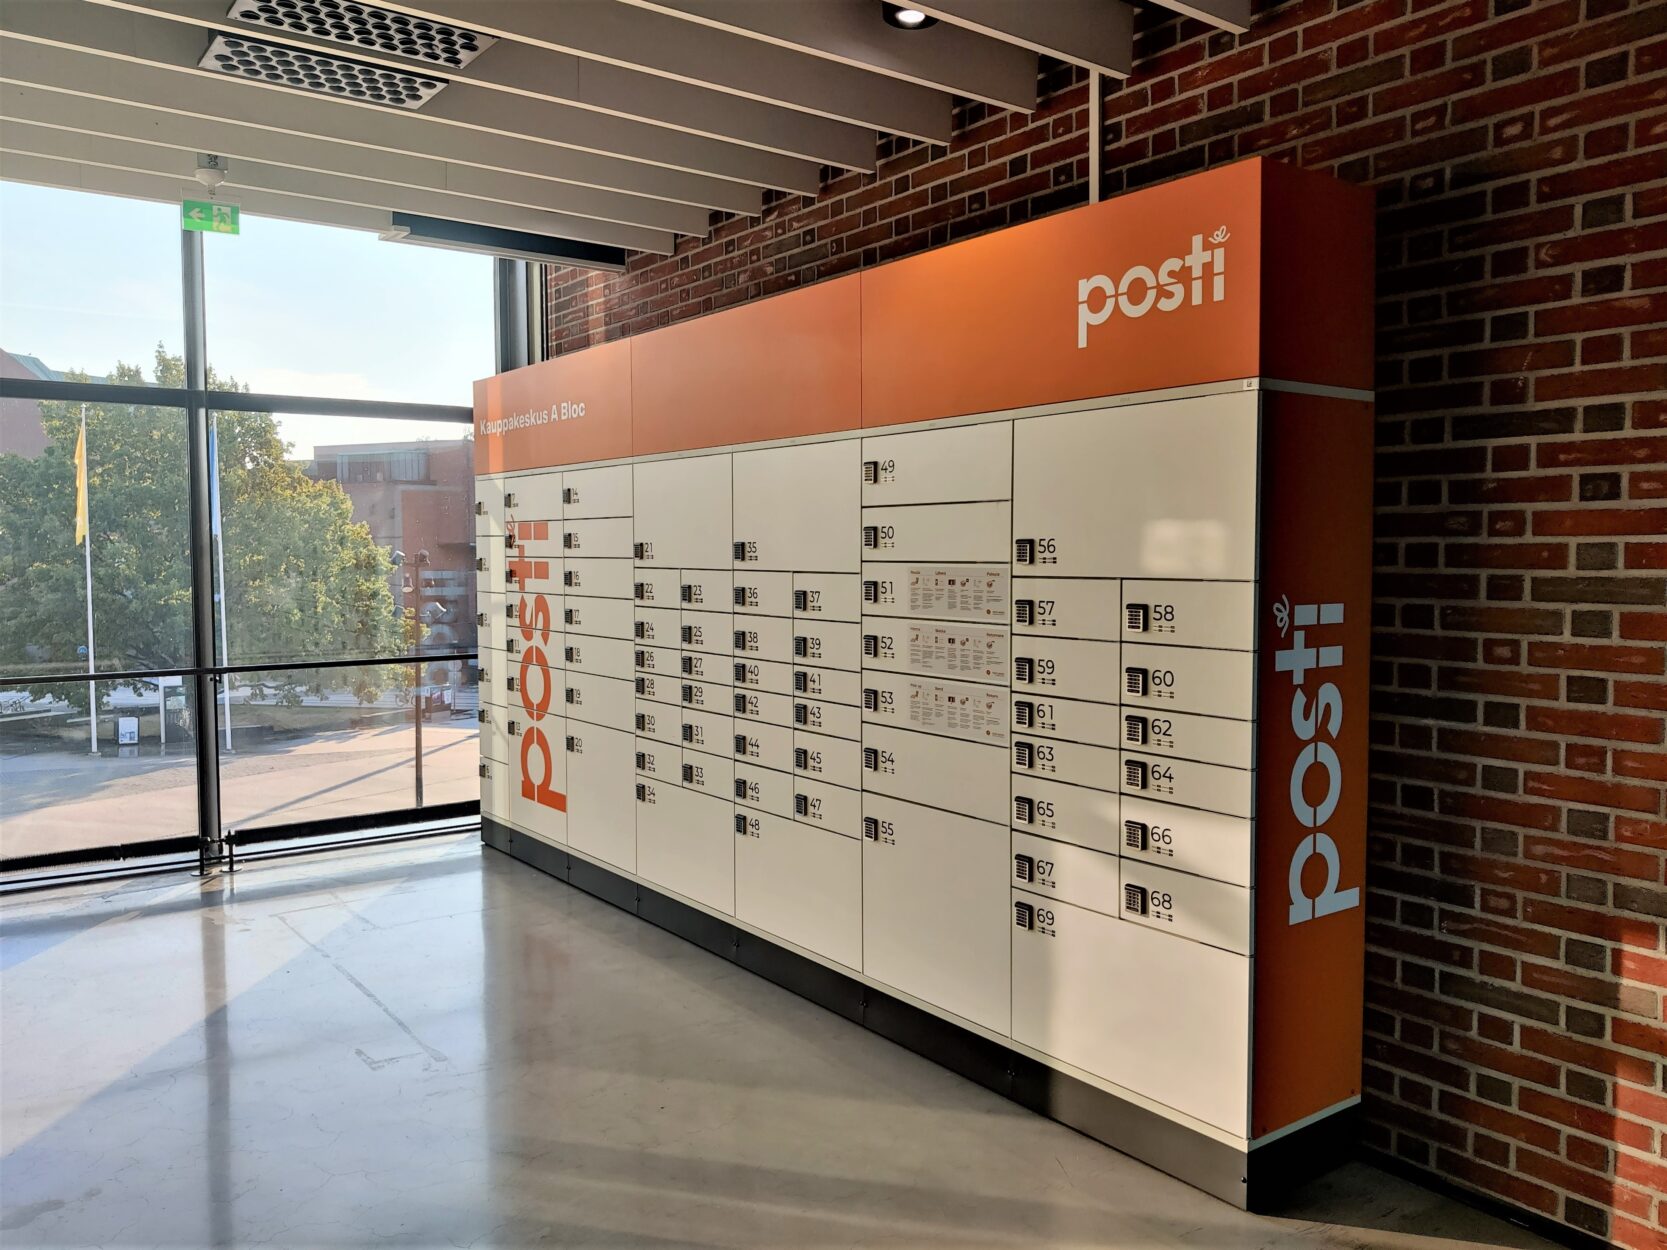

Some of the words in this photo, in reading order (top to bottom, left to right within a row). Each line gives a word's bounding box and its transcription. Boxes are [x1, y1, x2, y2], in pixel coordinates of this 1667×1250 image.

[1078, 225, 1231, 349] posti
[479, 409, 548, 437] Kauppakeskus
[550, 404, 559, 422] A
[561, 402, 586, 420] Bloc
[880, 459, 895, 474] 49
[880, 525, 895, 540] 50
[644, 542, 653, 553] 21
[747, 541, 757, 554] 35
[1037, 538, 1056, 554] 56
[573, 571, 580, 581] 16
[645, 583, 654, 594] 22
[693, 585, 702, 596] 23
[747, 587, 758, 599] 36
[880, 581, 894, 595] 51
[809, 590, 821, 603] 37
[574, 609, 580, 618] 17
[1037, 600, 1055, 616] 57
[1152, 604, 1175, 622] 58
[645, 622, 654, 632] 24
[693, 626, 702, 637] 25
[747, 631, 758, 644] 38
[809, 638, 821, 650] 39
[880, 635, 894, 650] 52
[574, 647, 581, 657] 18
[645, 651, 655, 662] 26
[507, 514, 567, 813] posti
[693, 657, 703, 669] 27
[1037, 659, 1055, 675] 59
[748, 664, 760, 677] 40
[646, 678, 655, 689] 28
[809, 673, 821, 686] 41
[1151, 669, 1175, 687] 60
[574, 689, 581, 699] 19
[694, 686, 703, 698] 29
[880, 690, 894, 705] 53
[748, 696, 759, 708] 42
[809, 706, 821, 719] 43
[1036, 703, 1054, 720] 61
[646, 715, 655, 726] 30
[694, 725, 703, 737] 31
[1151, 718, 1173, 737] 62
[575, 738, 583, 748] 20
[748, 737, 760, 750] 44
[646, 754, 655, 765] 32
[809, 751, 822, 764] 45
[880, 750, 895, 766] 54
[1036, 744, 1054, 762] 63
[1273, 594, 1360, 926] posti
[694, 766, 704, 778] 33
[1151, 764, 1174, 783] 64
[647, 786, 656, 797] 34
[748, 782, 760, 794] 46
[809, 798, 822, 811] 47
[1036, 800, 1054, 818] 65
[748, 818, 760, 831] 48
[880, 820, 894, 836] 55
[1150, 825, 1173, 845] 66
[1036, 859, 1054, 877] 67
[1150, 890, 1173, 910] 68
[1036, 908, 1055, 926] 69
